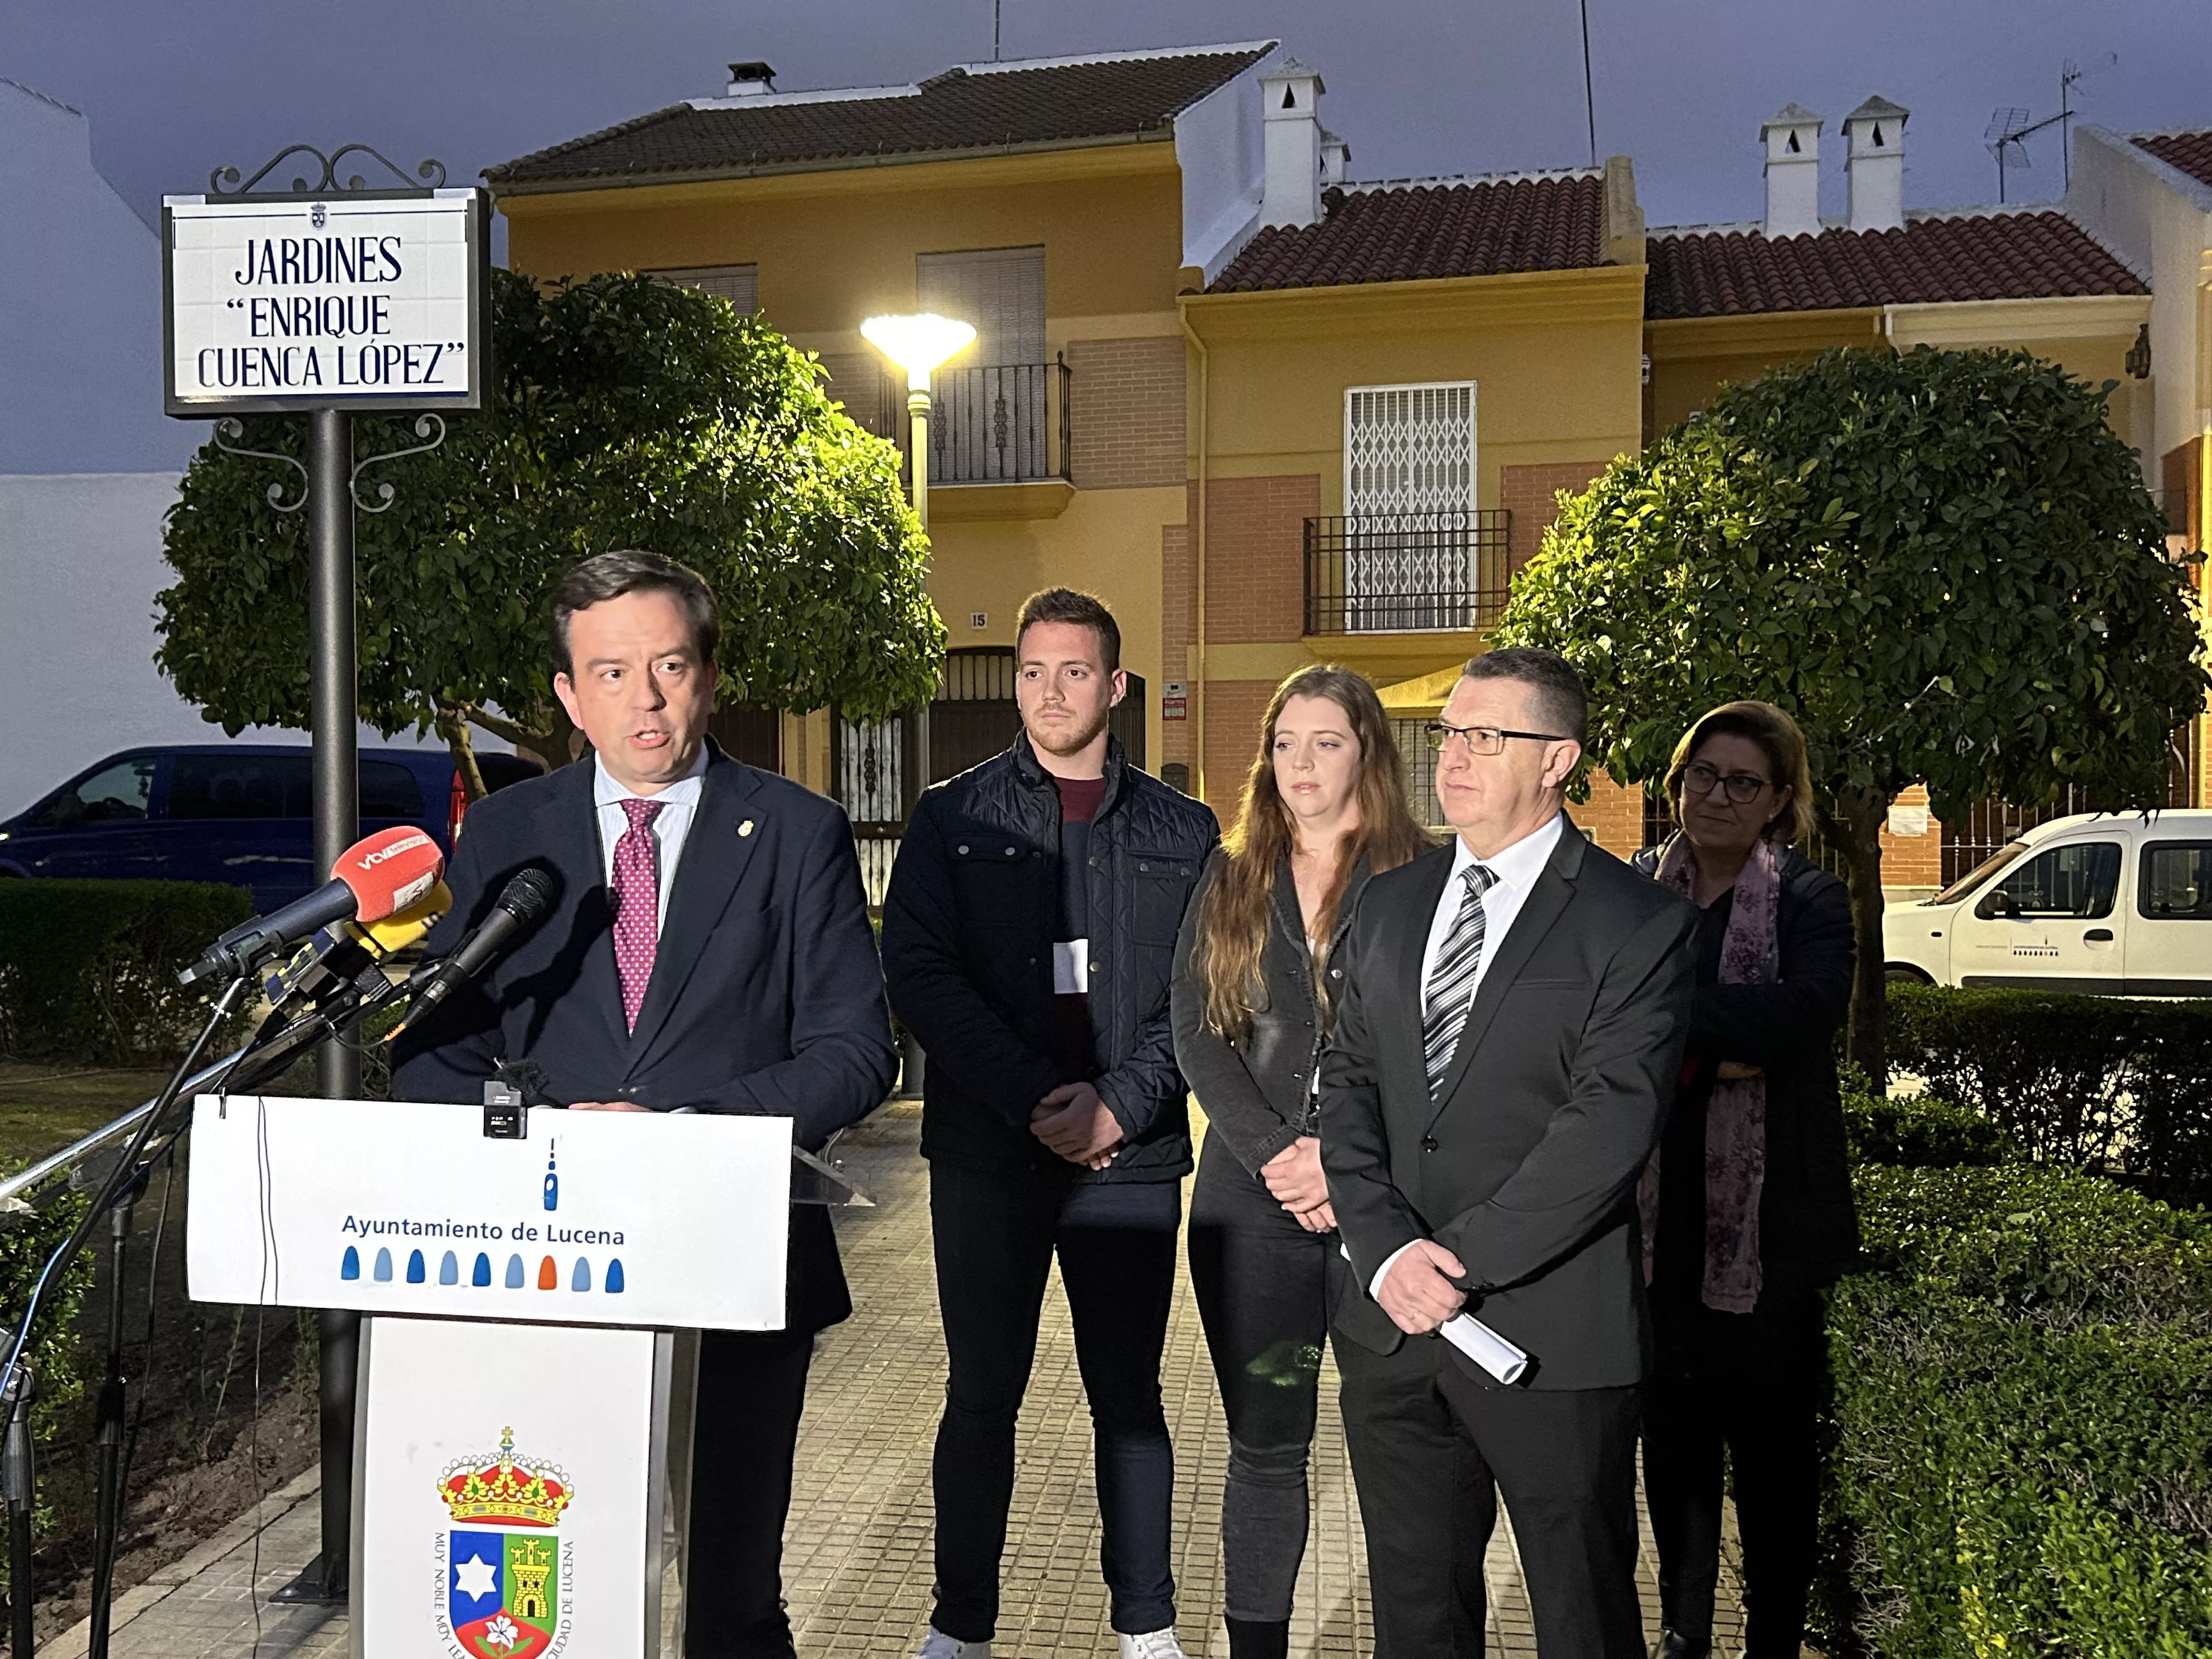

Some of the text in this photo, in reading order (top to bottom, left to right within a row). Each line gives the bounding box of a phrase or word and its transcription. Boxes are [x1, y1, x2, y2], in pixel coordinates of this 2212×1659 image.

[235, 236, 402, 285] JARDINES
[227, 295, 391, 338] “ENRIQUE
[198, 339, 465, 387] CUENCA LÓPEZ”
[973, 614, 985, 627] 15
[342, 1215, 624, 1245] Ayuntamiento de Lucena
[435, 1532, 445, 1563] MUY
[562, 1540, 574, 1592] LUCENA
[434, 1569, 445, 1610] NOBLE
[562, 1598, 573, 1615] DE
[435, 1615, 453, 1641] MUY
